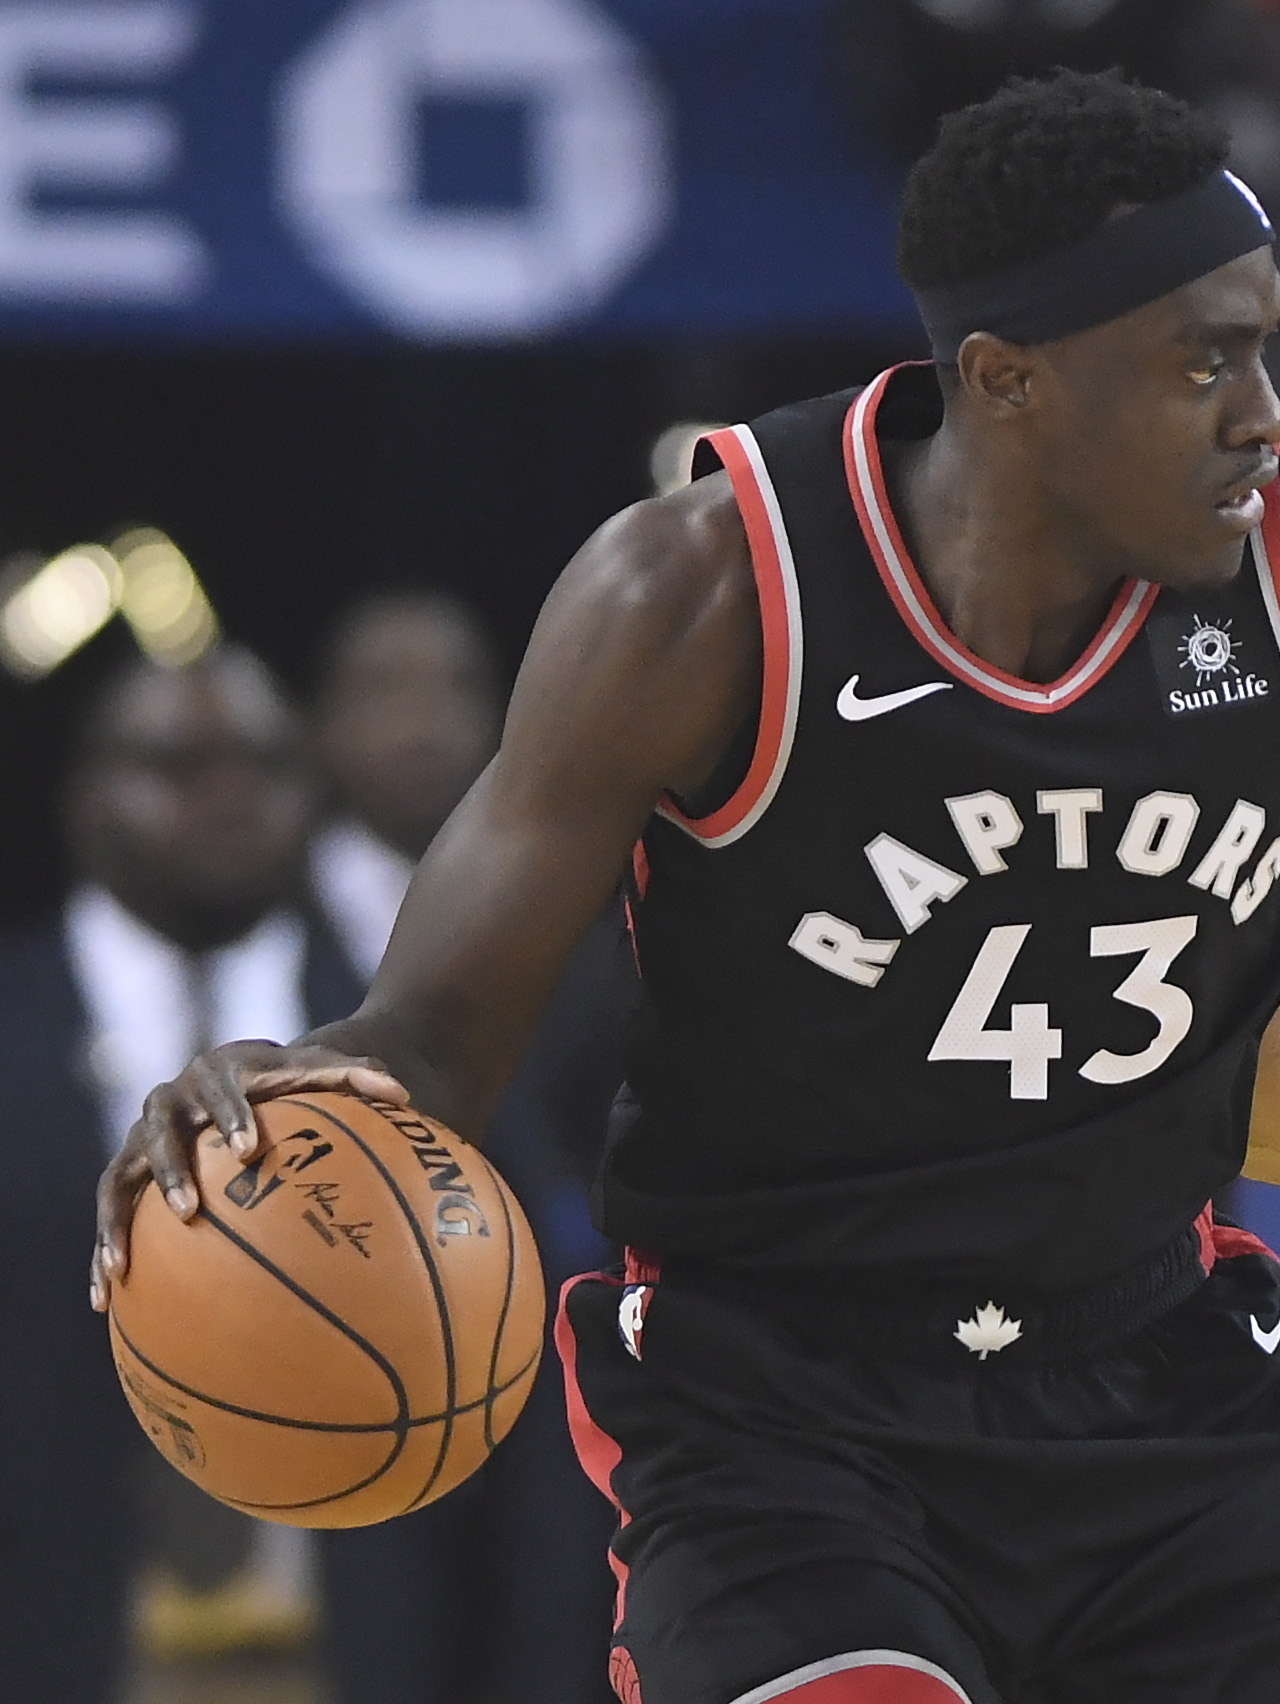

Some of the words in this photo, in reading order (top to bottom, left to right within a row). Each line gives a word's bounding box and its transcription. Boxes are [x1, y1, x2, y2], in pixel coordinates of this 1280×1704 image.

[1169, 689, 1218, 713] Sun
[1221, 673, 1269, 702] Life
[927, 914, 1198, 1100] 43
[360, 1098, 491, 1248] LDING
